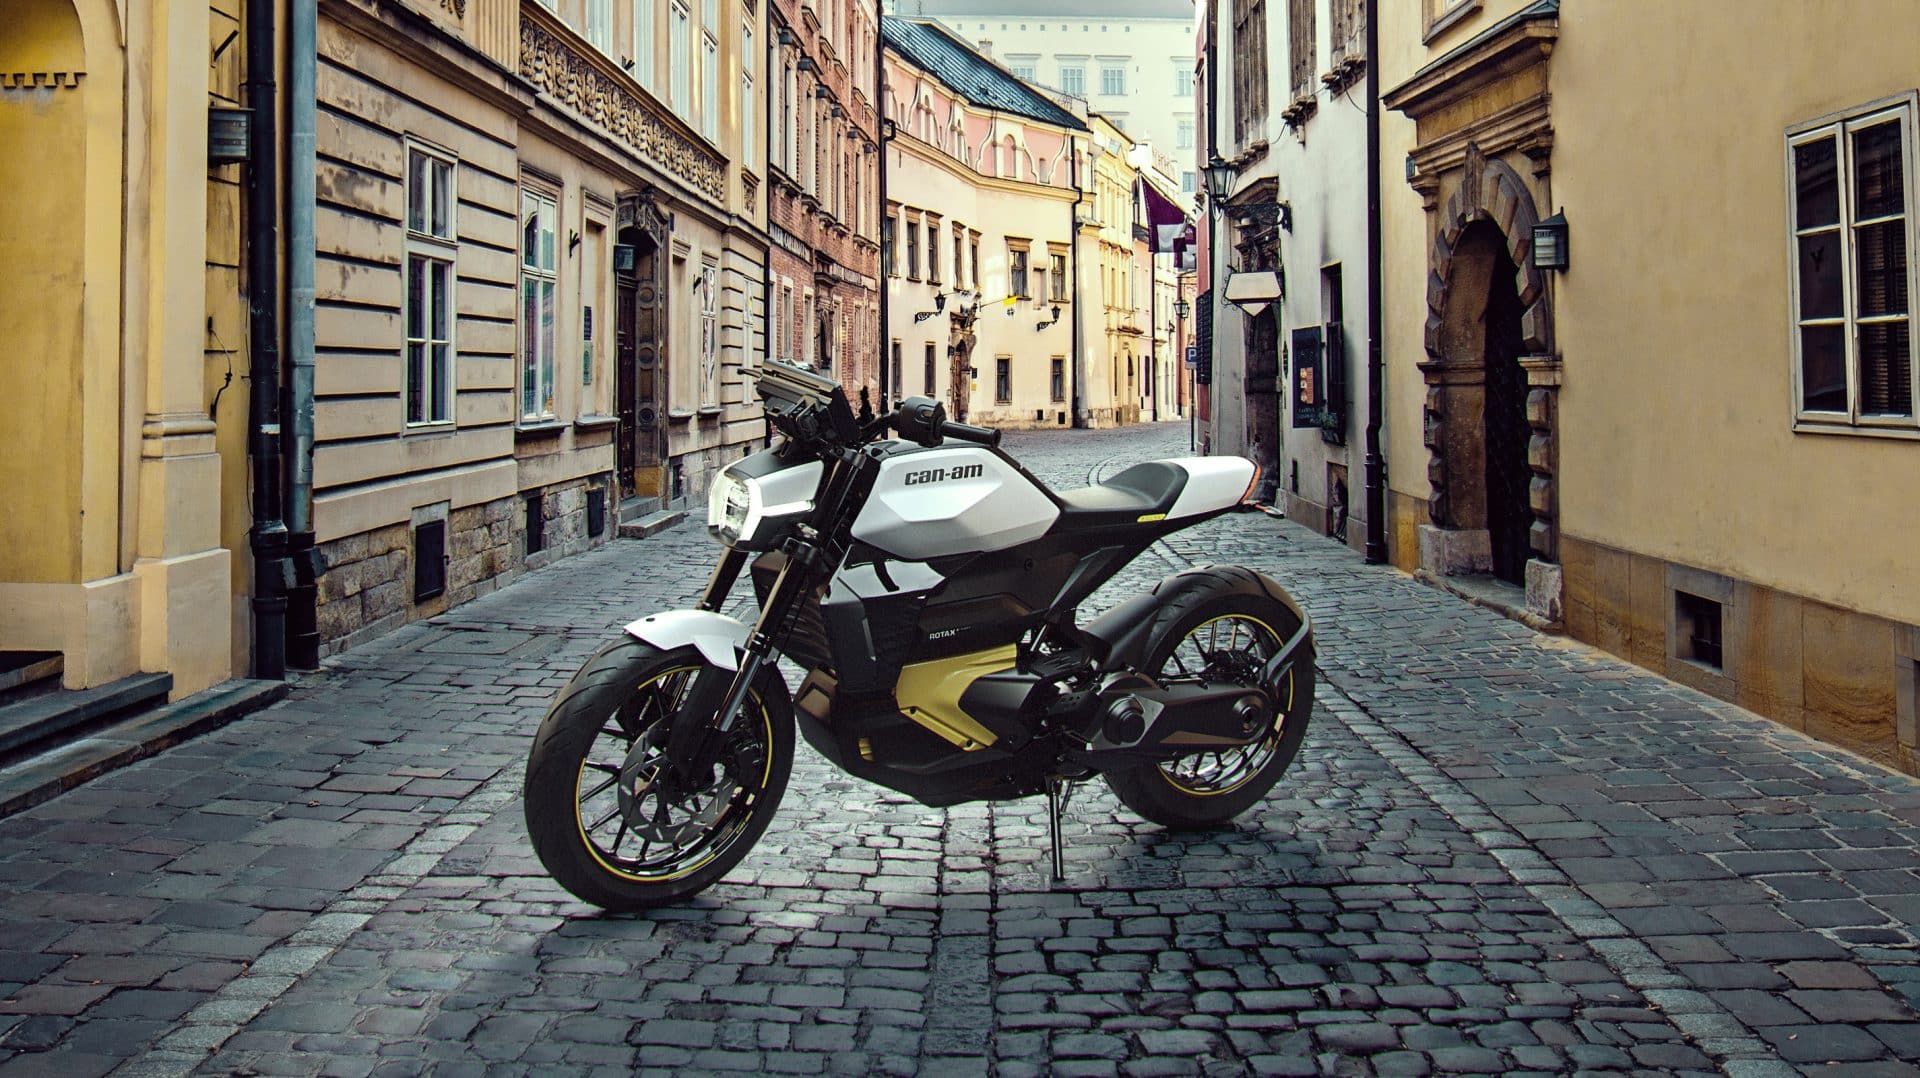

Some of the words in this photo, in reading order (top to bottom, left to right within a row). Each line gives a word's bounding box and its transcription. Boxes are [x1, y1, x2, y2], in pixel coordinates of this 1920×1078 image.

[1188, 348, 1197, 361] P
[904, 464, 983, 486] can-am
[929, 629, 956, 641] ROTAX
